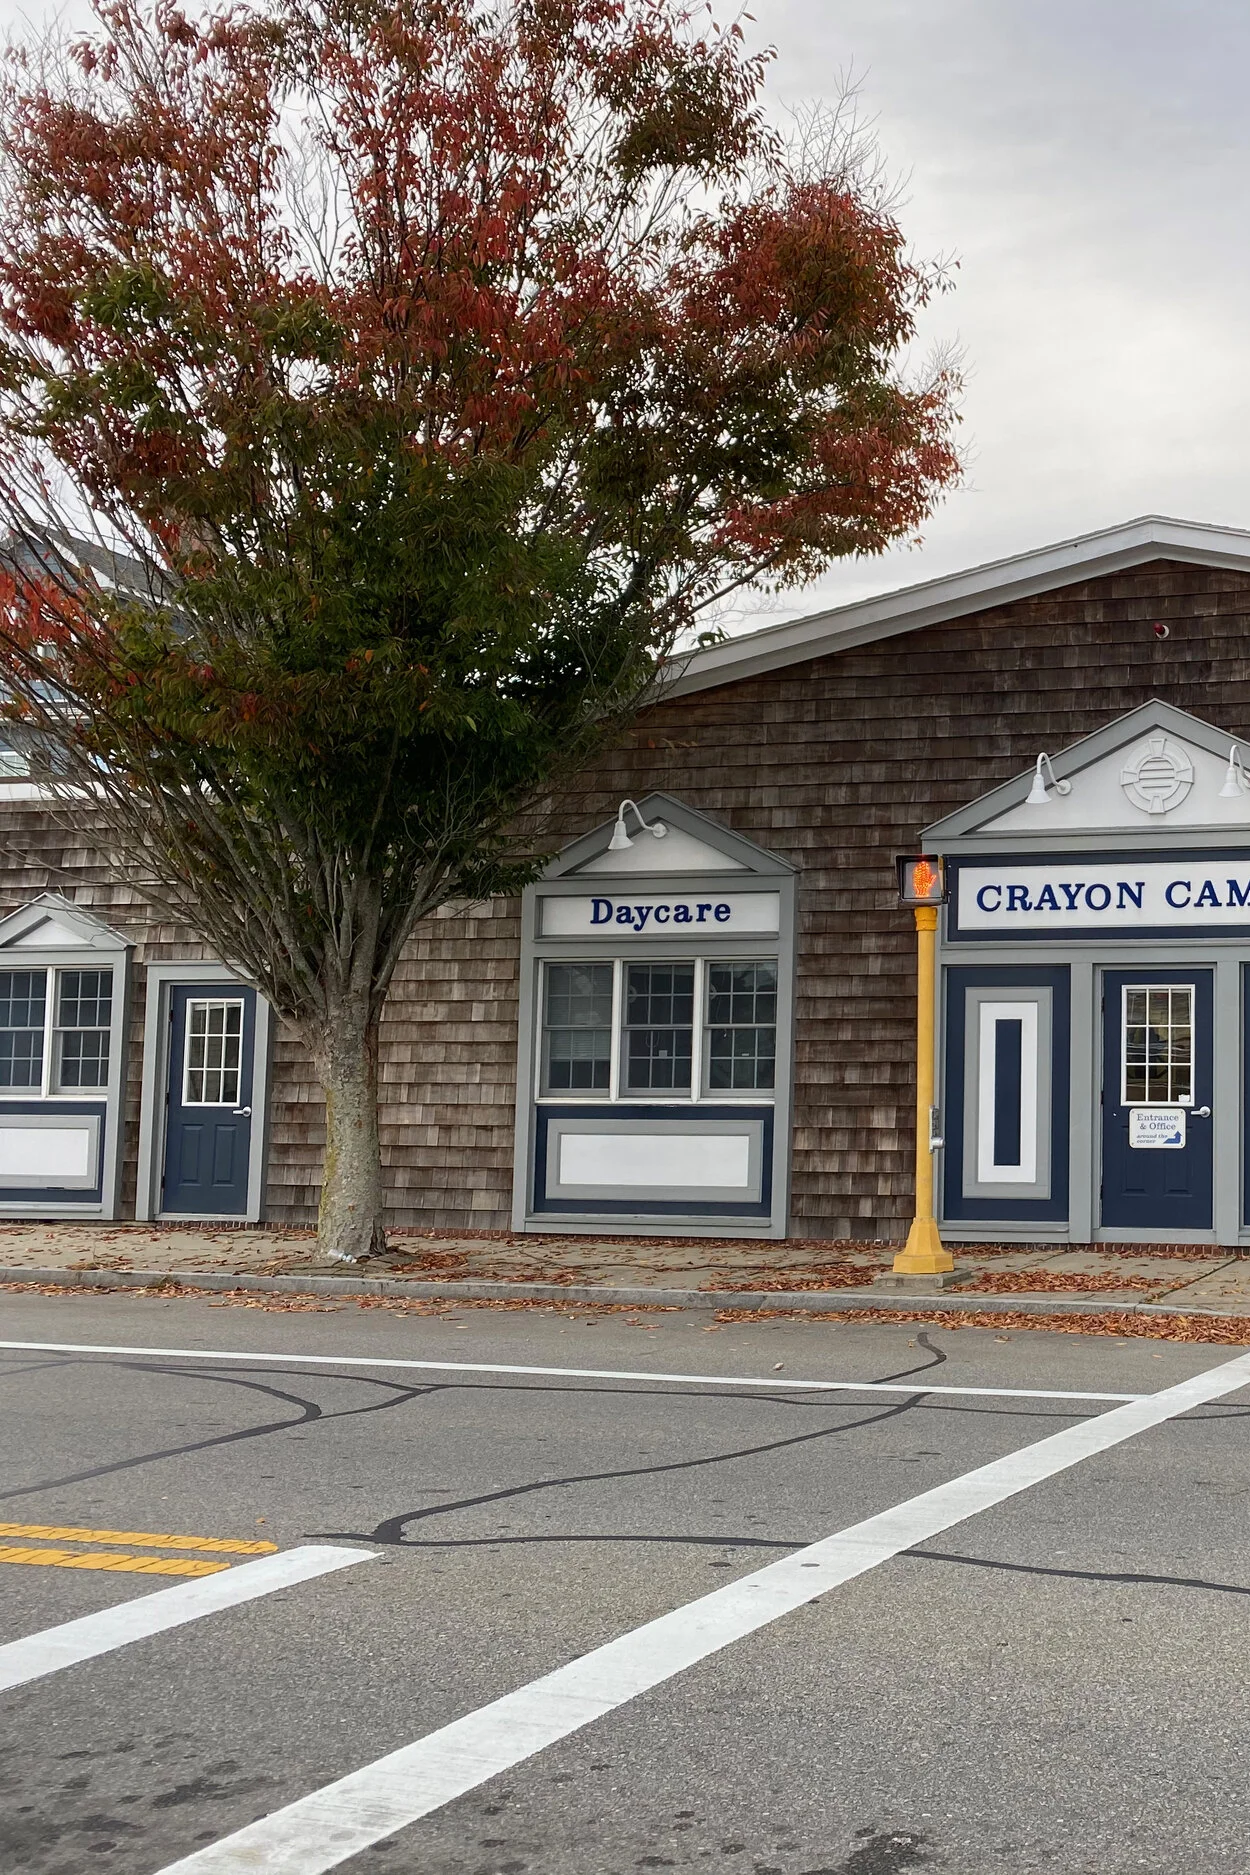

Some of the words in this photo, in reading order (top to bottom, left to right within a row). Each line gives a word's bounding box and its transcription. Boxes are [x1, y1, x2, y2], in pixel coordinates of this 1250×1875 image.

[976, 881, 1146, 912] CRAYON
[590, 898, 731, 931] Daycare
[1136, 1113, 1179, 1121] Entrance
[1140, 1122, 1146, 1130] &
[1149, 1122, 1176, 1130] Office
